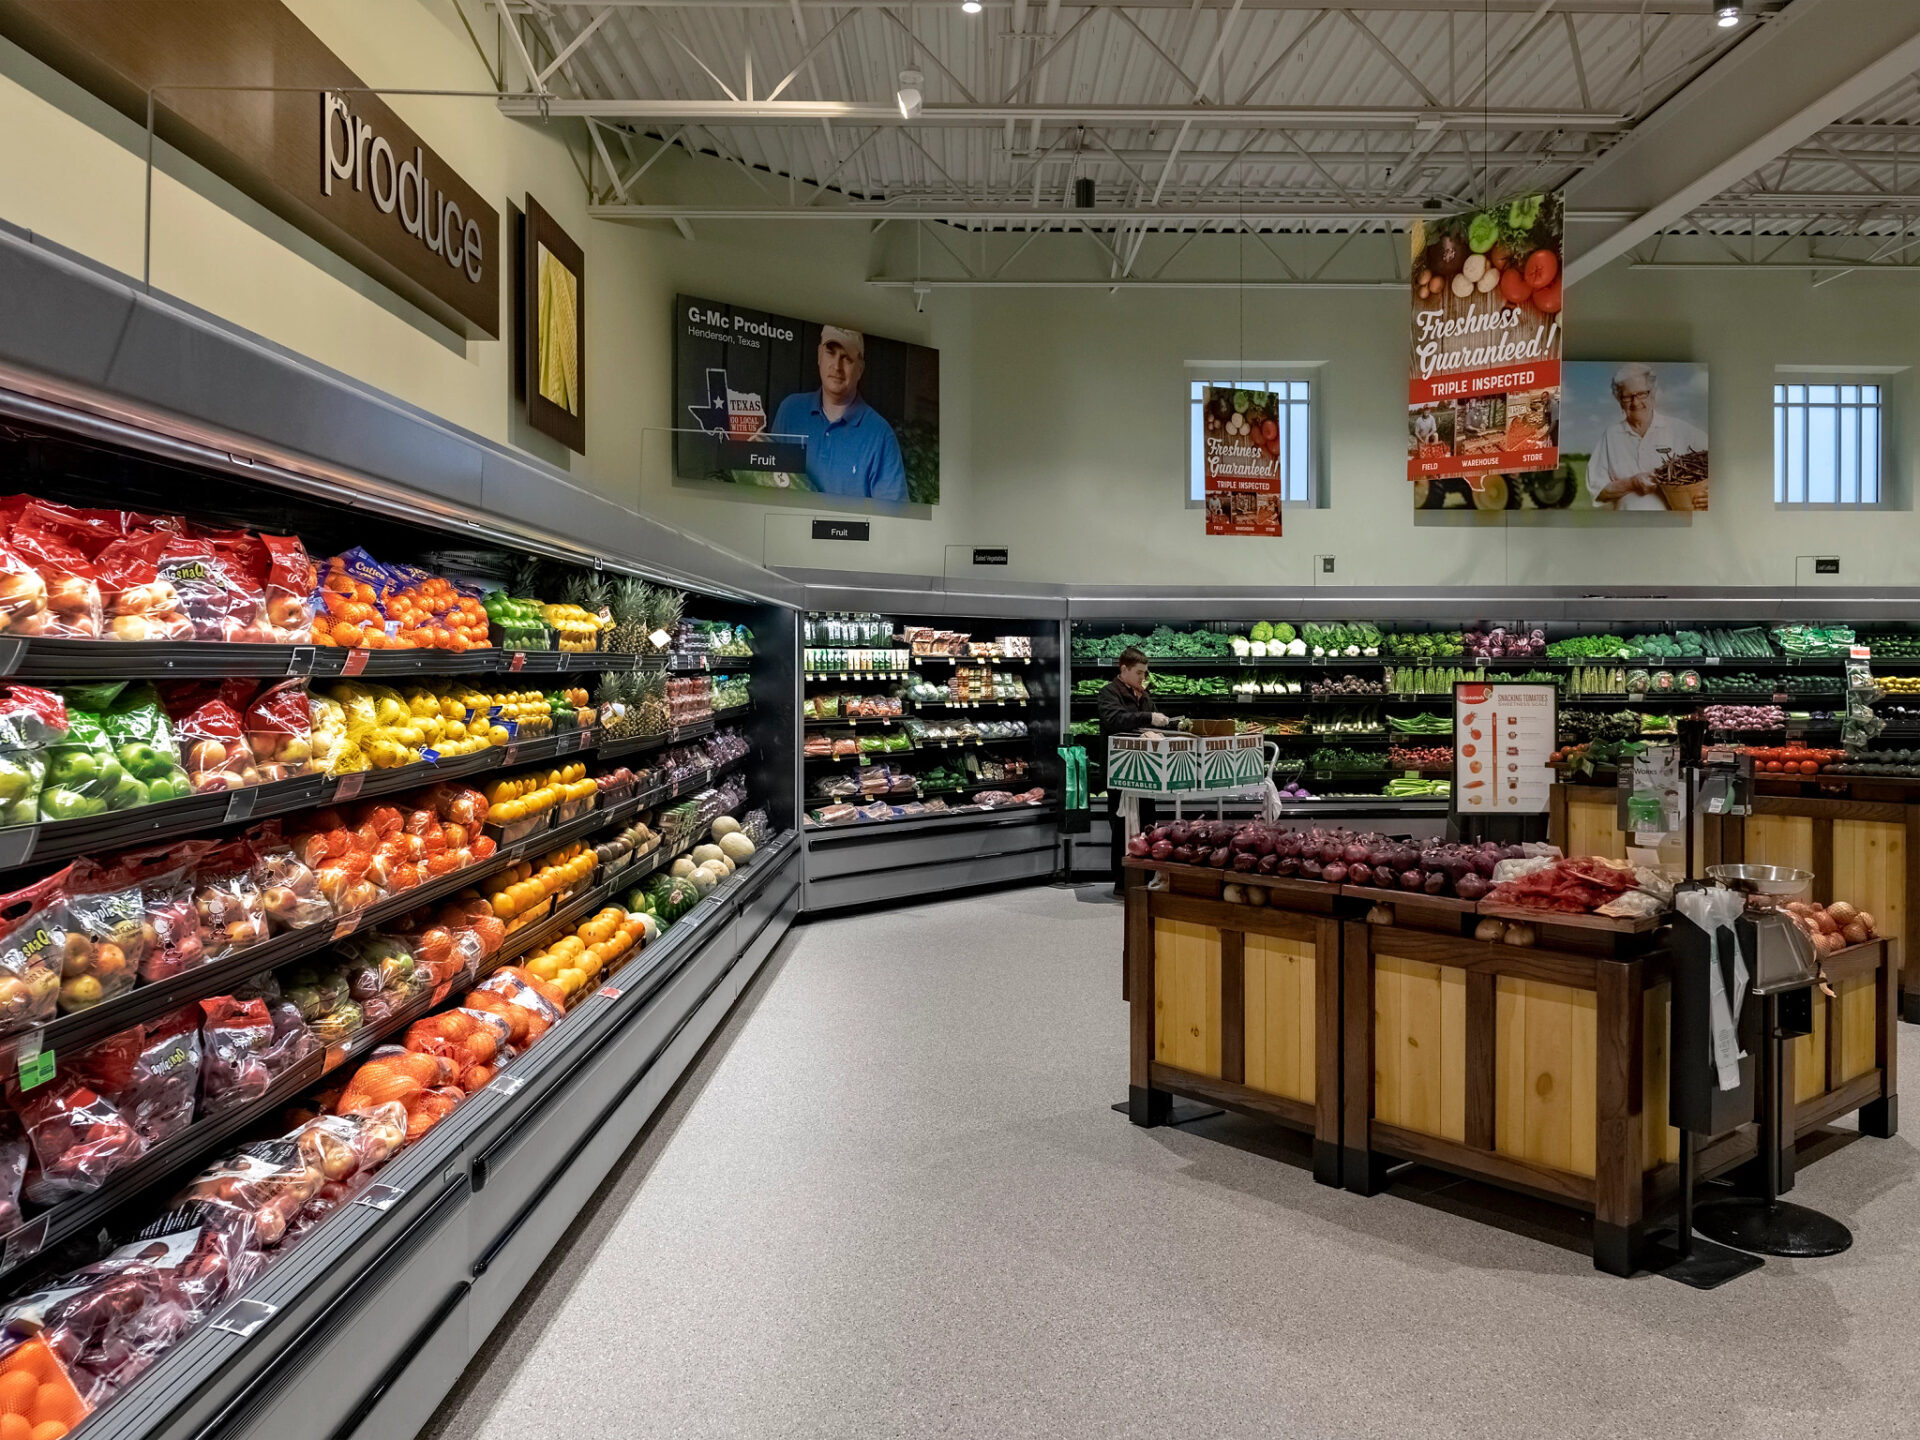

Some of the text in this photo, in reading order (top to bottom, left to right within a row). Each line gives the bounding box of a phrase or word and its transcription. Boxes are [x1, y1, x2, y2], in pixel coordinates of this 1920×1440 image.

[323, 91, 483, 283] produce
[688, 306, 795, 342] G-Mc Produce
[1416, 303, 1522, 342] Freshness
[688, 325, 761, 349] Henderson, Texas
[1416, 323, 1557, 381] Guaranteed!
[1431, 370, 1535, 396] TRIPLE INSPECTED
[730, 400, 761, 412] TEXAS
[739, 416, 760, 424] LOCAL
[748, 424, 757, 432] US
[1207, 437, 1262, 458] Freshness
[750, 454, 776, 466] Fruit
[1207, 456, 1279, 478] Guaranteed!
[1421, 453, 1543, 471] FIELD WAREHOUSE STORE
[1216, 480, 1270, 491] TRIPLE INSPECTED
[830, 527, 848, 537] Fruit
[1113, 780, 1158, 790] VEGETABLES
